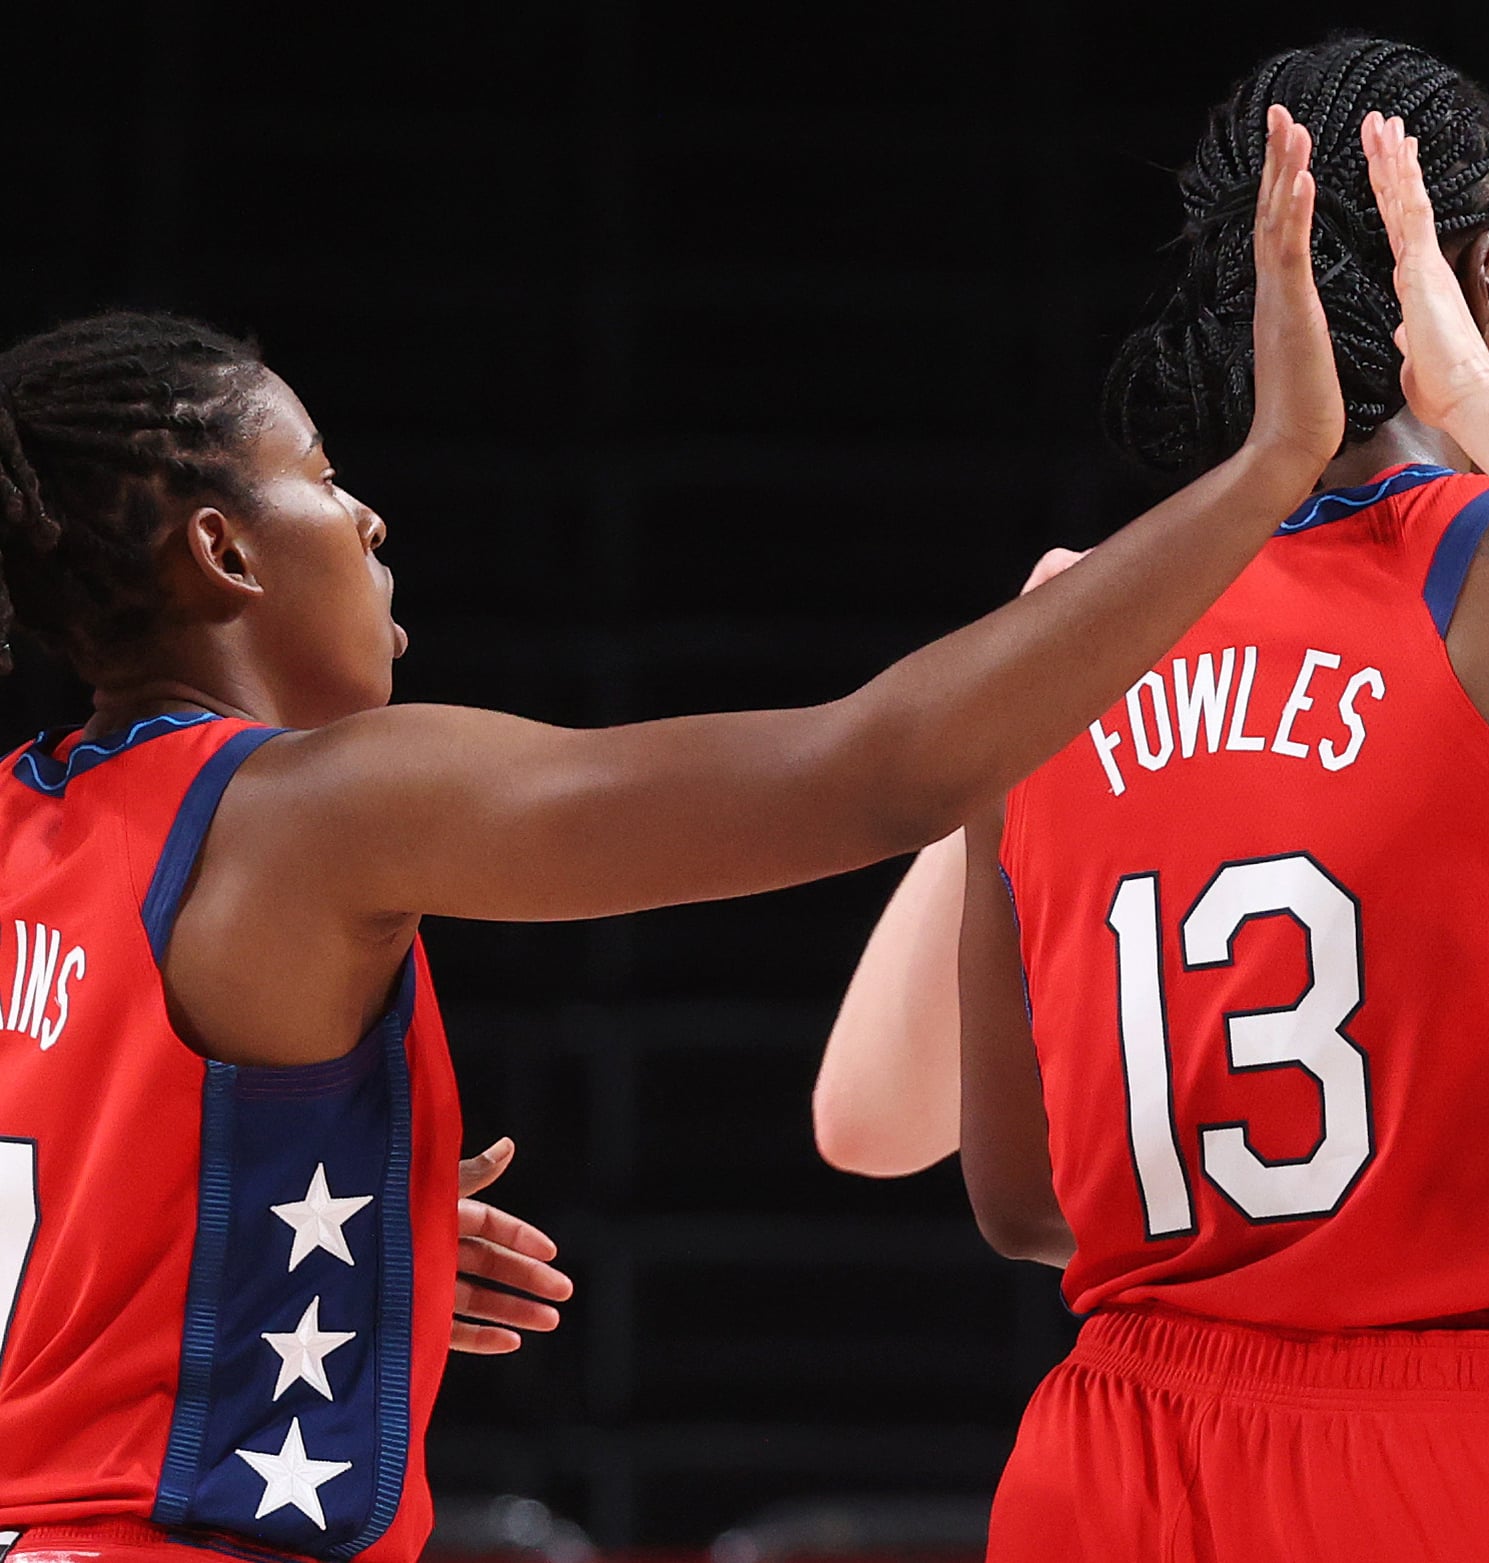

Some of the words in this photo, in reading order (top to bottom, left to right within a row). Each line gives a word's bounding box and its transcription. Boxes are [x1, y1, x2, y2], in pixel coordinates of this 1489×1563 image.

[1088, 645, 1386, 797] FOWLES
[0, 918, 87, 1052] INS
[1105, 850, 1376, 1243] 13
